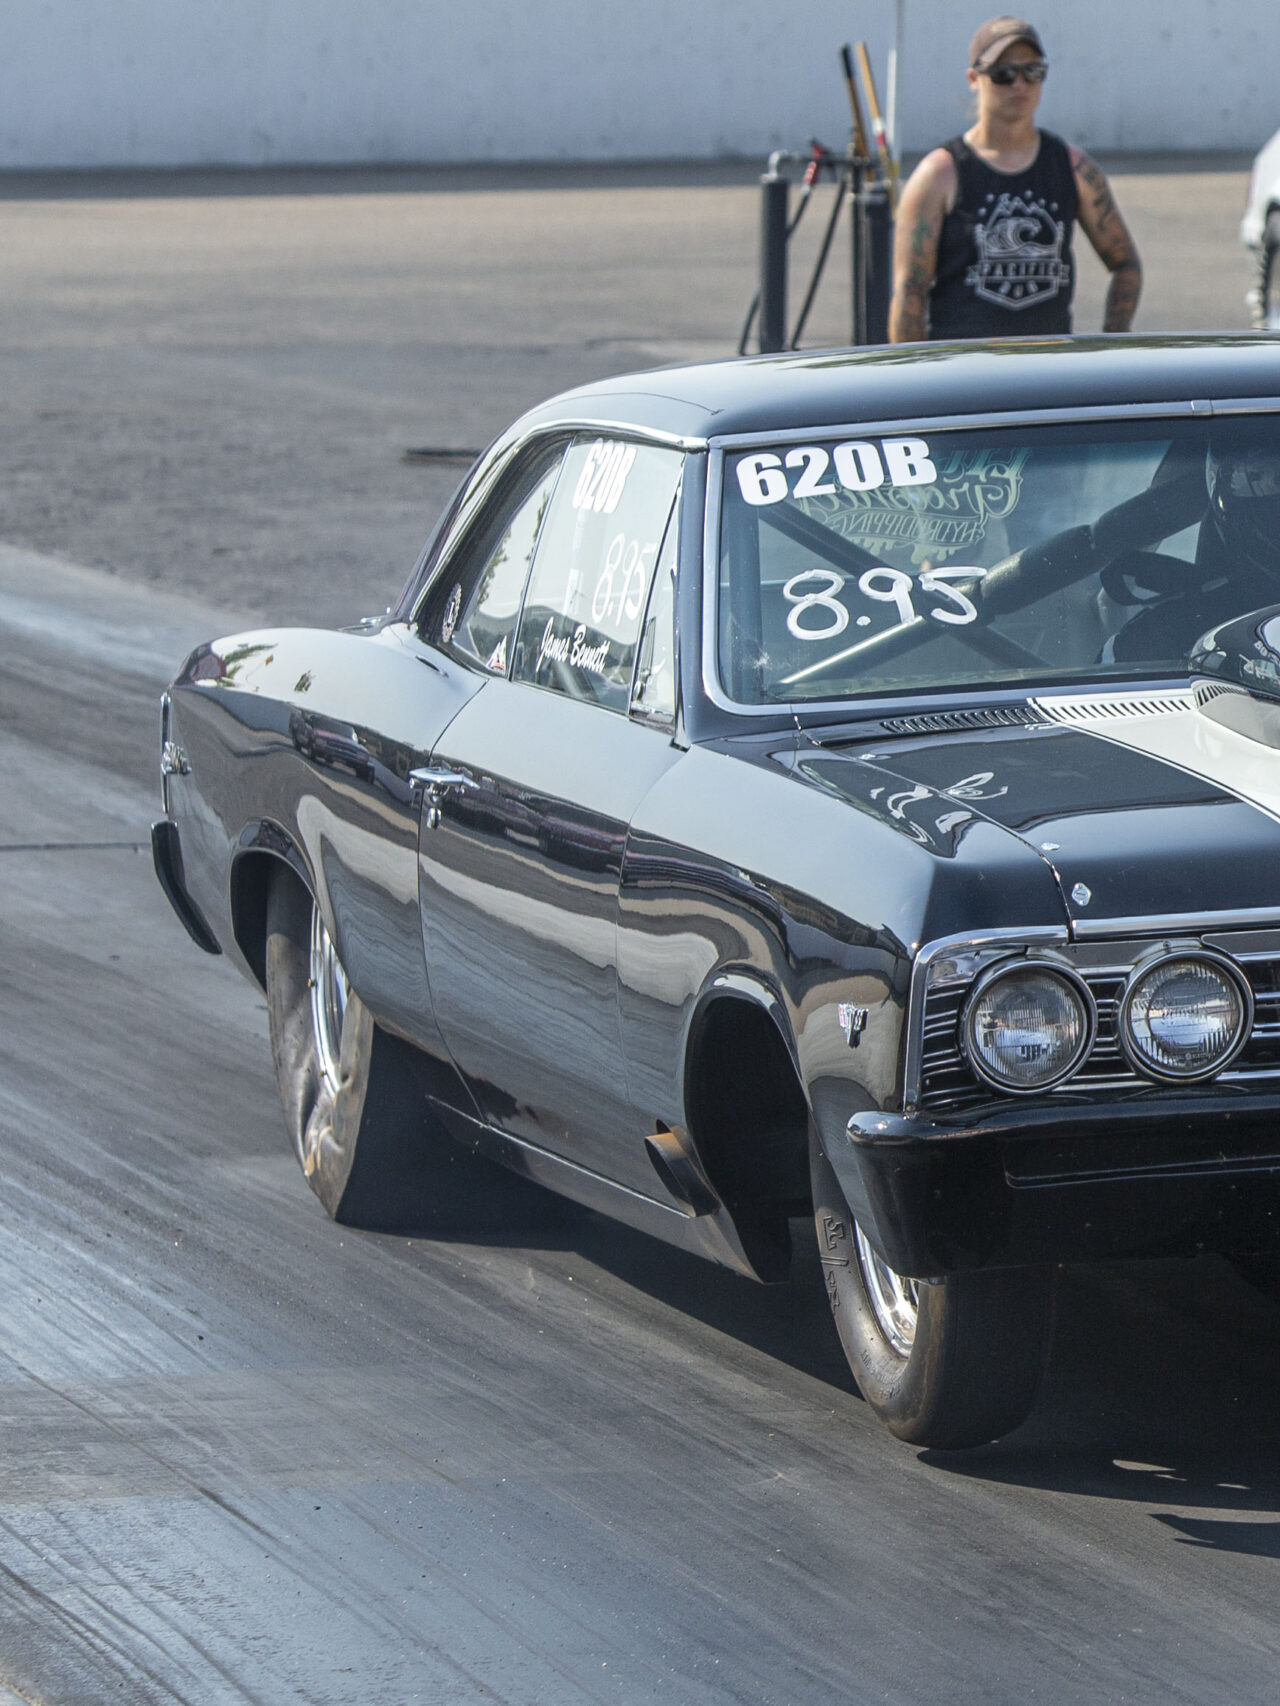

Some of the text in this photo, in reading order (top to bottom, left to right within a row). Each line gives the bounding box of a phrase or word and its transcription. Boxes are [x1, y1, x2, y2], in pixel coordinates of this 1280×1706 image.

[736, 438, 937, 506] 620B
[592, 533, 659, 628] 8.95
[783, 566, 987, 640] 8.95
[535, 616, 612, 673] James Bennett
